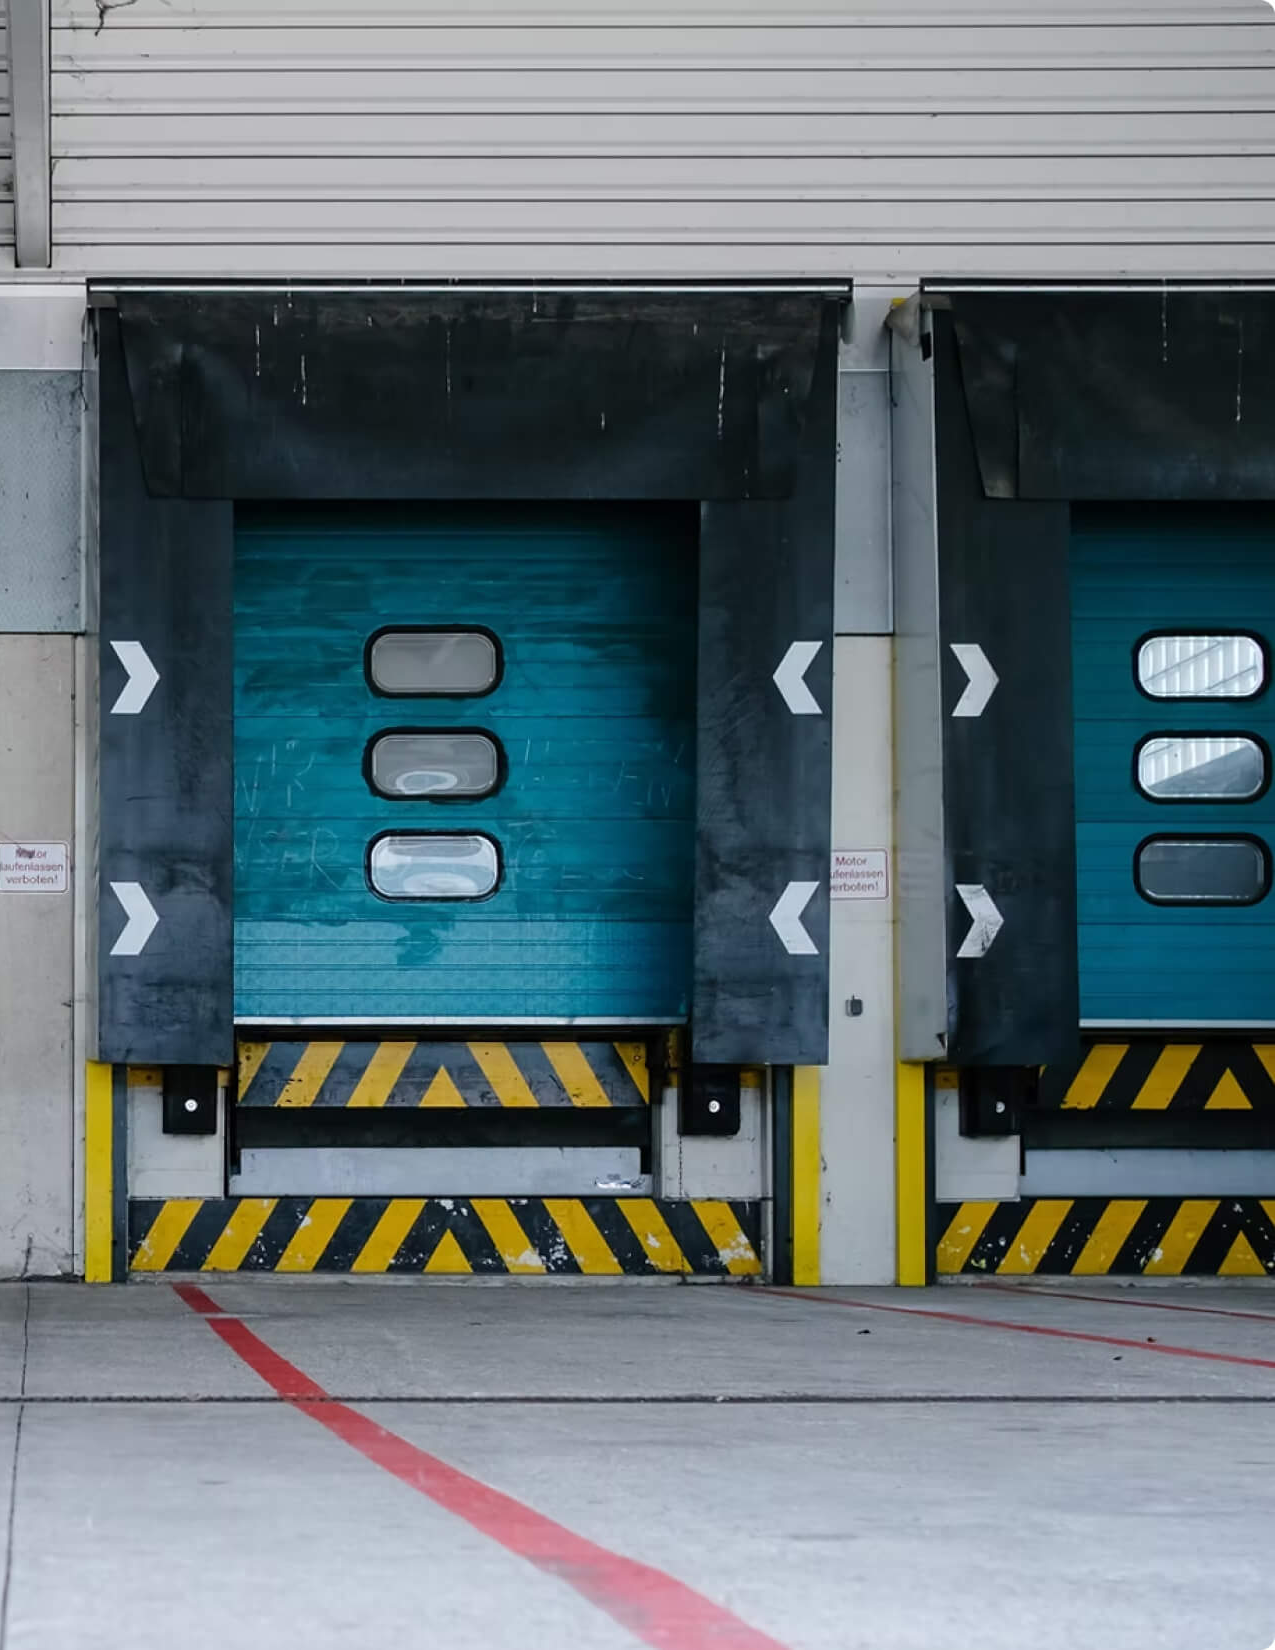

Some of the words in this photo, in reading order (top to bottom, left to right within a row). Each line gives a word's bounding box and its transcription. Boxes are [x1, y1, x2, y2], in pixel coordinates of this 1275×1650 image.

[835, 856, 867, 866] Motor
[0, 862, 63, 872] laufenlassen
[830, 869, 884, 879] ufenlassen
[5, 875, 58, 884] verboten!
